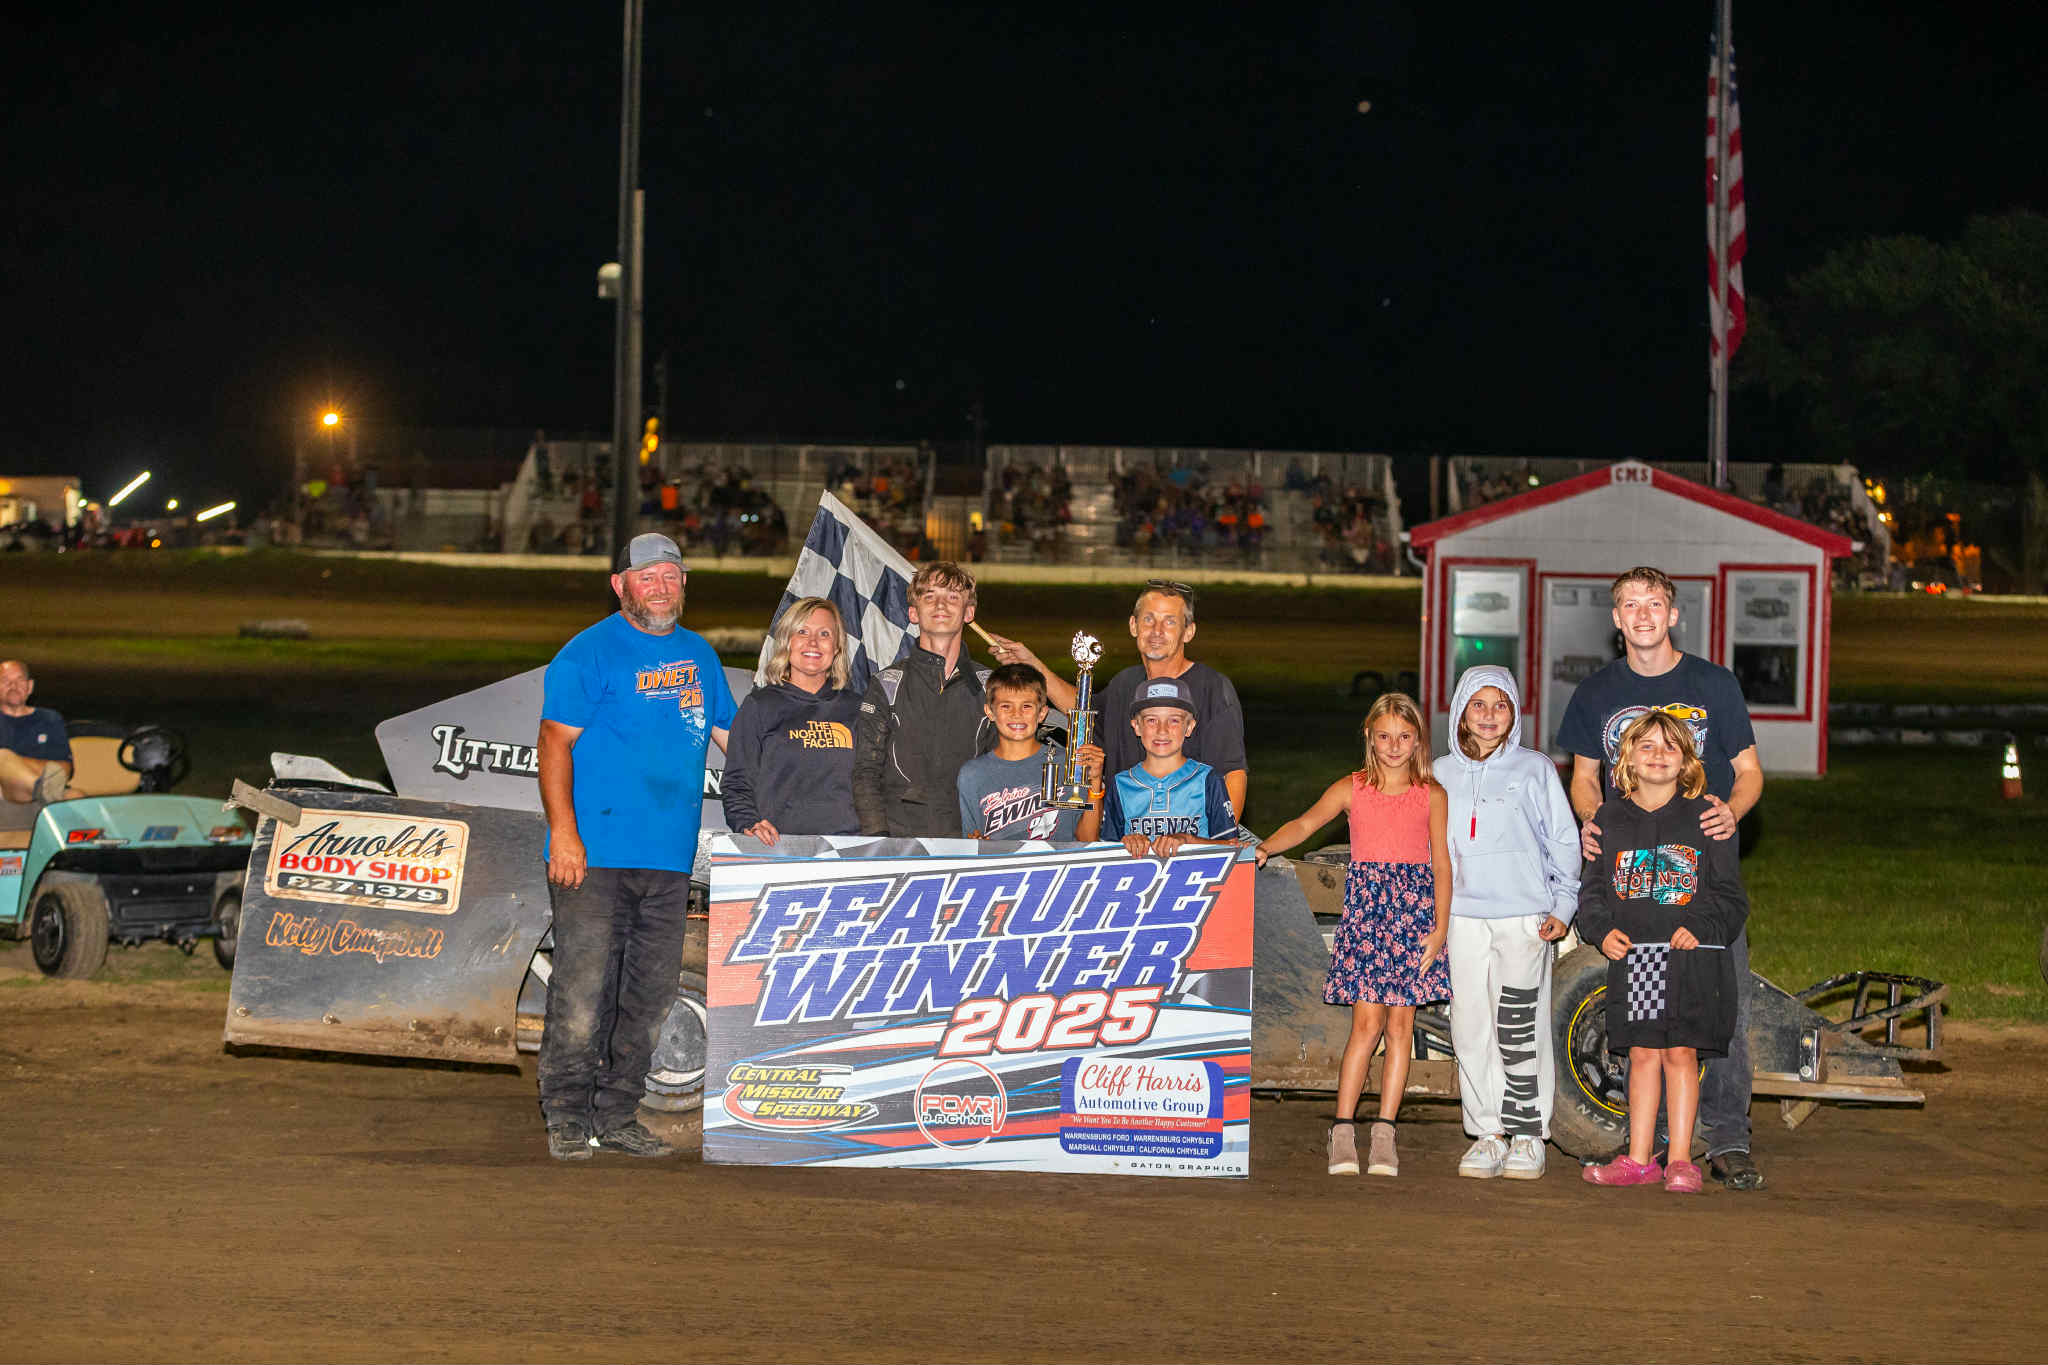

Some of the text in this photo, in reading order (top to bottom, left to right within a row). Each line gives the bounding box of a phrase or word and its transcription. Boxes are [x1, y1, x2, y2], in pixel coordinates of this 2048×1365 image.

[1616, 467, 1649, 482] CMS
[806, 720, 830, 730] THE
[789, 729, 833, 739] NORTH
[803, 738, 834, 749] FACE
[984, 792, 1042, 836] EWIN
[281, 821, 456, 858] Arnold's
[279, 853, 453, 885] BODY SHOP
[287, 875, 443, 902] 827-1379
[731, 851, 1235, 963] FEATURE
[754, 926, 1198, 1027] WINNER
[938, 983, 1165, 1057] 2025
[731, 1066, 820, 1082] CENTRAL
[1081, 1064, 1204, 1097] Cliff Harris
[741, 1084, 845, 1100] MISSOURI
[757, 1102, 866, 1117] SPEEDWAY
[1079, 1096, 1204, 1115] Automotive Group
[921, 1114, 993, 1125] RACING
[1064, 1132, 1215, 1145] WARRENSBURG FORD WARRENSBURG CHRYSLER
[1068, 1143, 1209, 1156] MARSHALL CHRYSLER CALIFORNIA CHRYSLER
[1131, 1162, 1242, 1173] GATOR GRAPHICS
